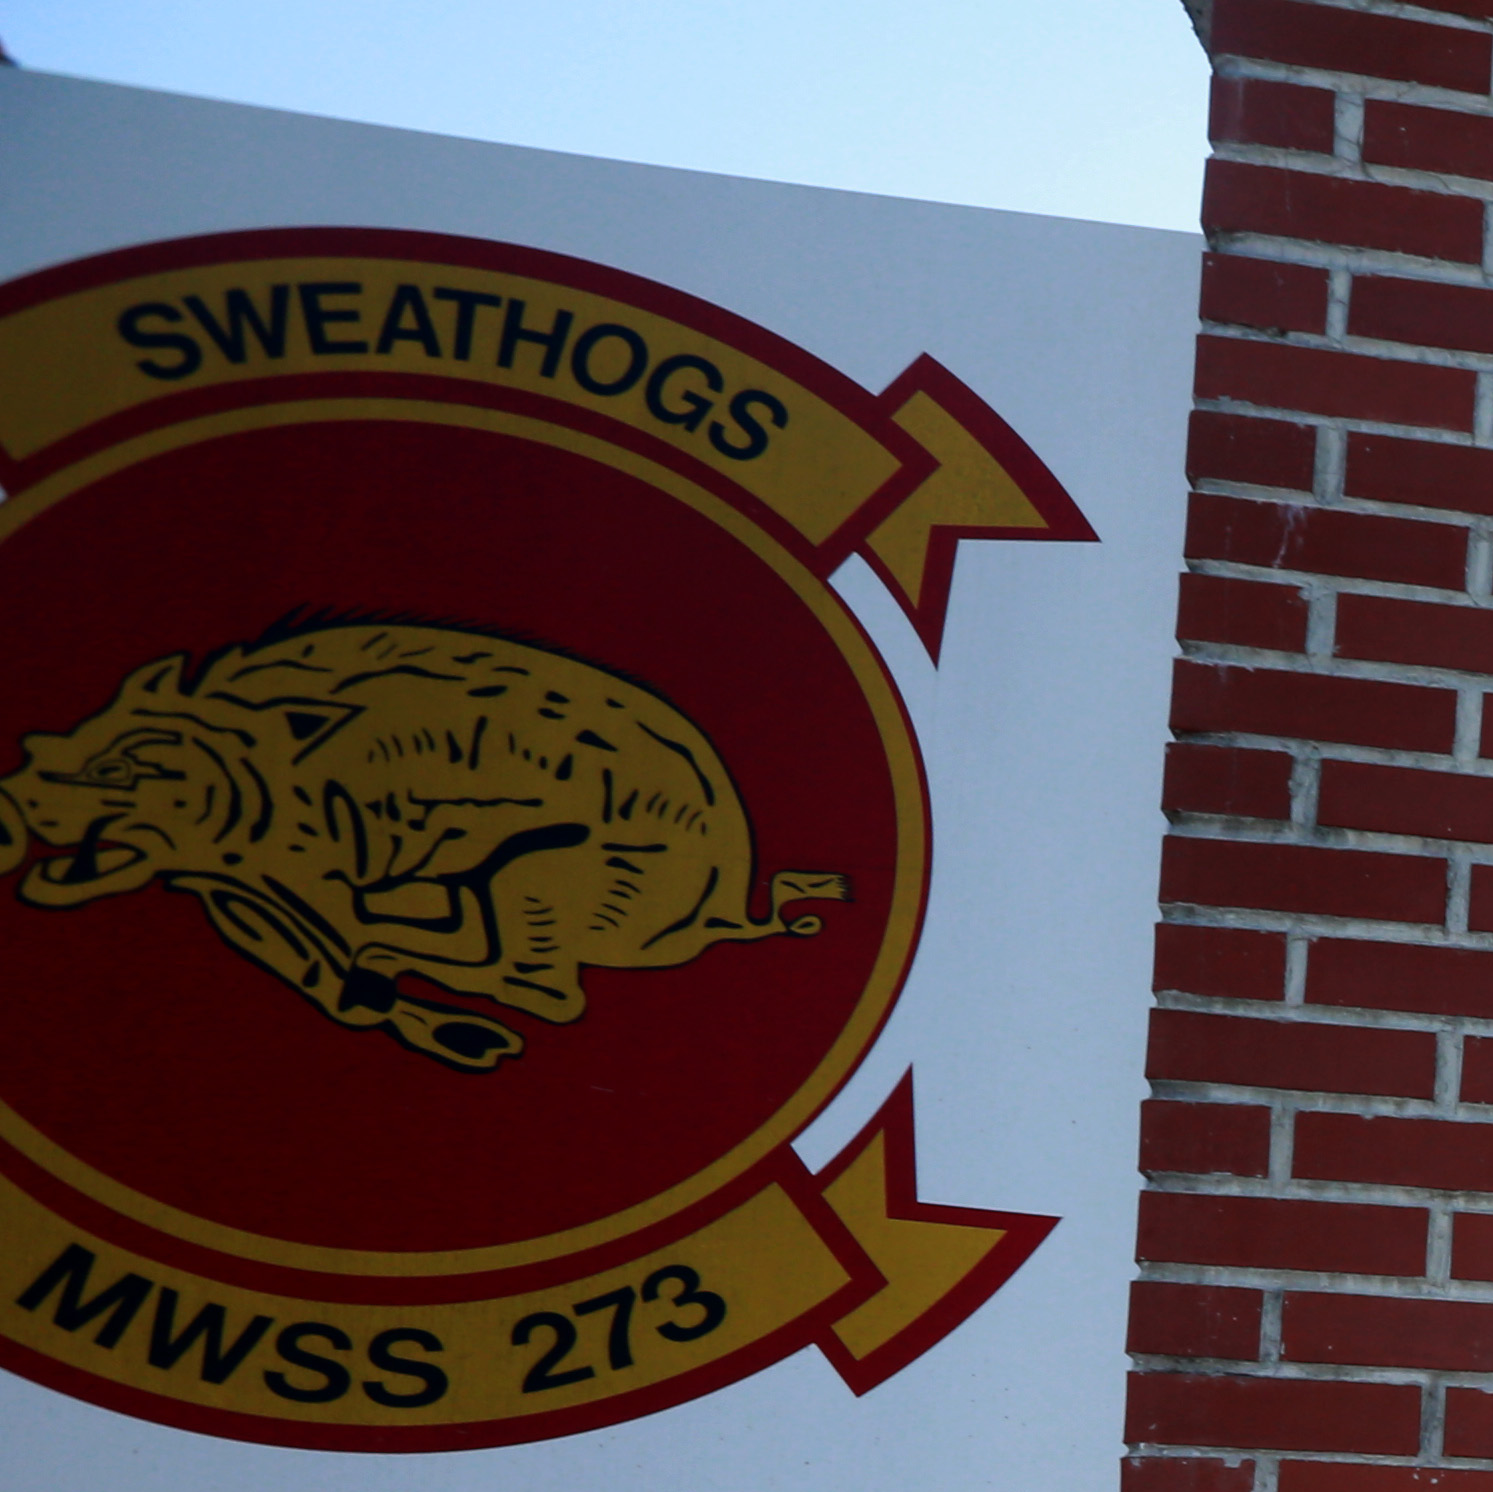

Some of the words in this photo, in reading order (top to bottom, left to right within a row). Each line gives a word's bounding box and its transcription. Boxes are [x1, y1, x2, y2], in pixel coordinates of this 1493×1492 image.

[116, 281, 789, 461] SWEATHOGS
[13, 1242, 450, 1408] MWSS
[510, 1263, 728, 1394] 273
